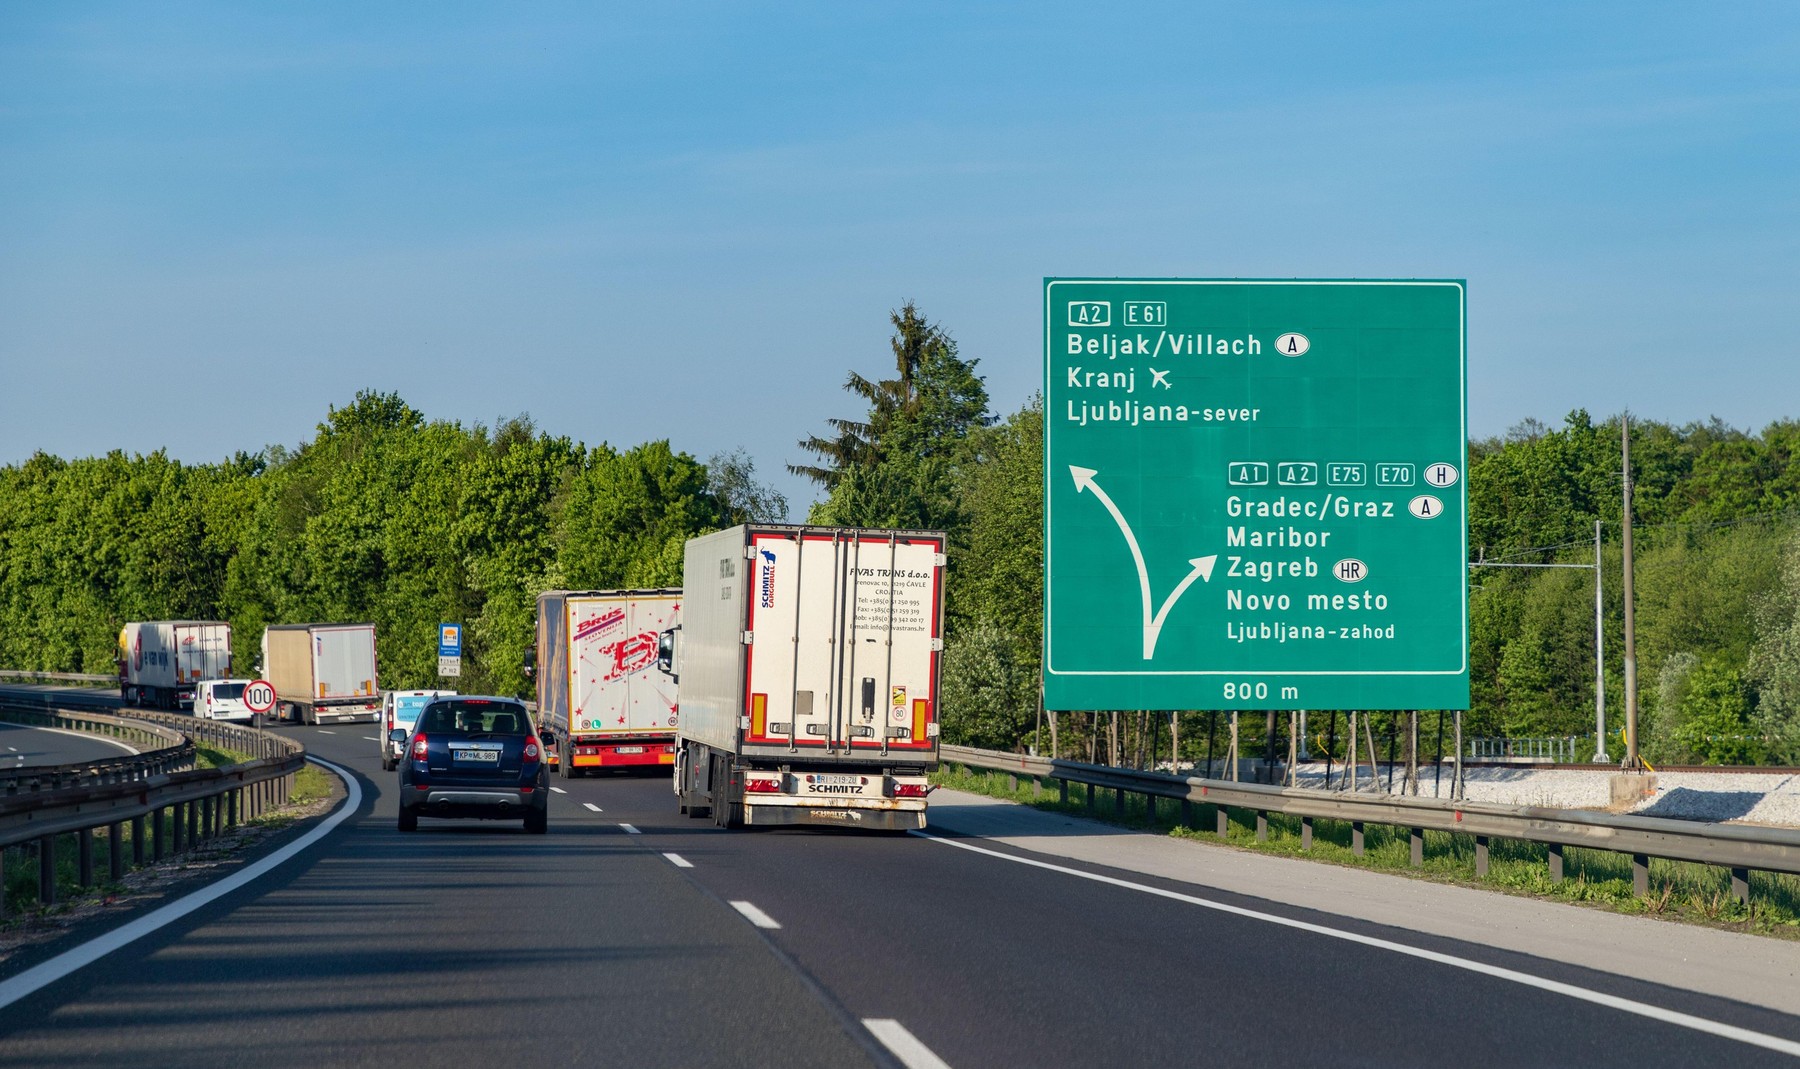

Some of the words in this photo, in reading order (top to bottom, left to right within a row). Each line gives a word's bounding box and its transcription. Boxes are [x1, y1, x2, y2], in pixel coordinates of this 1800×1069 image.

[1067, 330, 1261, 360] Beljak/Villach
[1287, 336, 1298, 353] A
[1067, 366, 1136, 394] Kranj
[1067, 400, 1260, 427] Ljubljana-sever
[1332, 466, 1361, 482] E75
[1381, 467, 1410, 483] E70
[1436, 466, 1447, 483] H
[1226, 494, 1395, 521] Gradec/Graz
[1421, 500, 1431, 516] A
[1227, 526, 1331, 548] Maribor
[850, 568, 874, 576] FVAS
[908, 570, 930, 578] d.o.o.
[1227, 556, 1318, 583] Zagreb
[1340, 563, 1360, 579] HR
[762, 565, 770, 608] SCHMITZ
[768, 565, 776, 608] CARGOBULL
[1227, 589, 1290, 611] Novo
[1307, 590, 1389, 611] mesto
[1227, 622, 1395, 643] Ljubljana-zahod
[248, 688, 272, 704] 100
[1223, 682, 1269, 700] 800
[1281, 686, 1299, 700] m
[593, 720, 599, 728] L
[895, 709, 904, 718] 80
[808, 784, 863, 794] SCHMITZ
